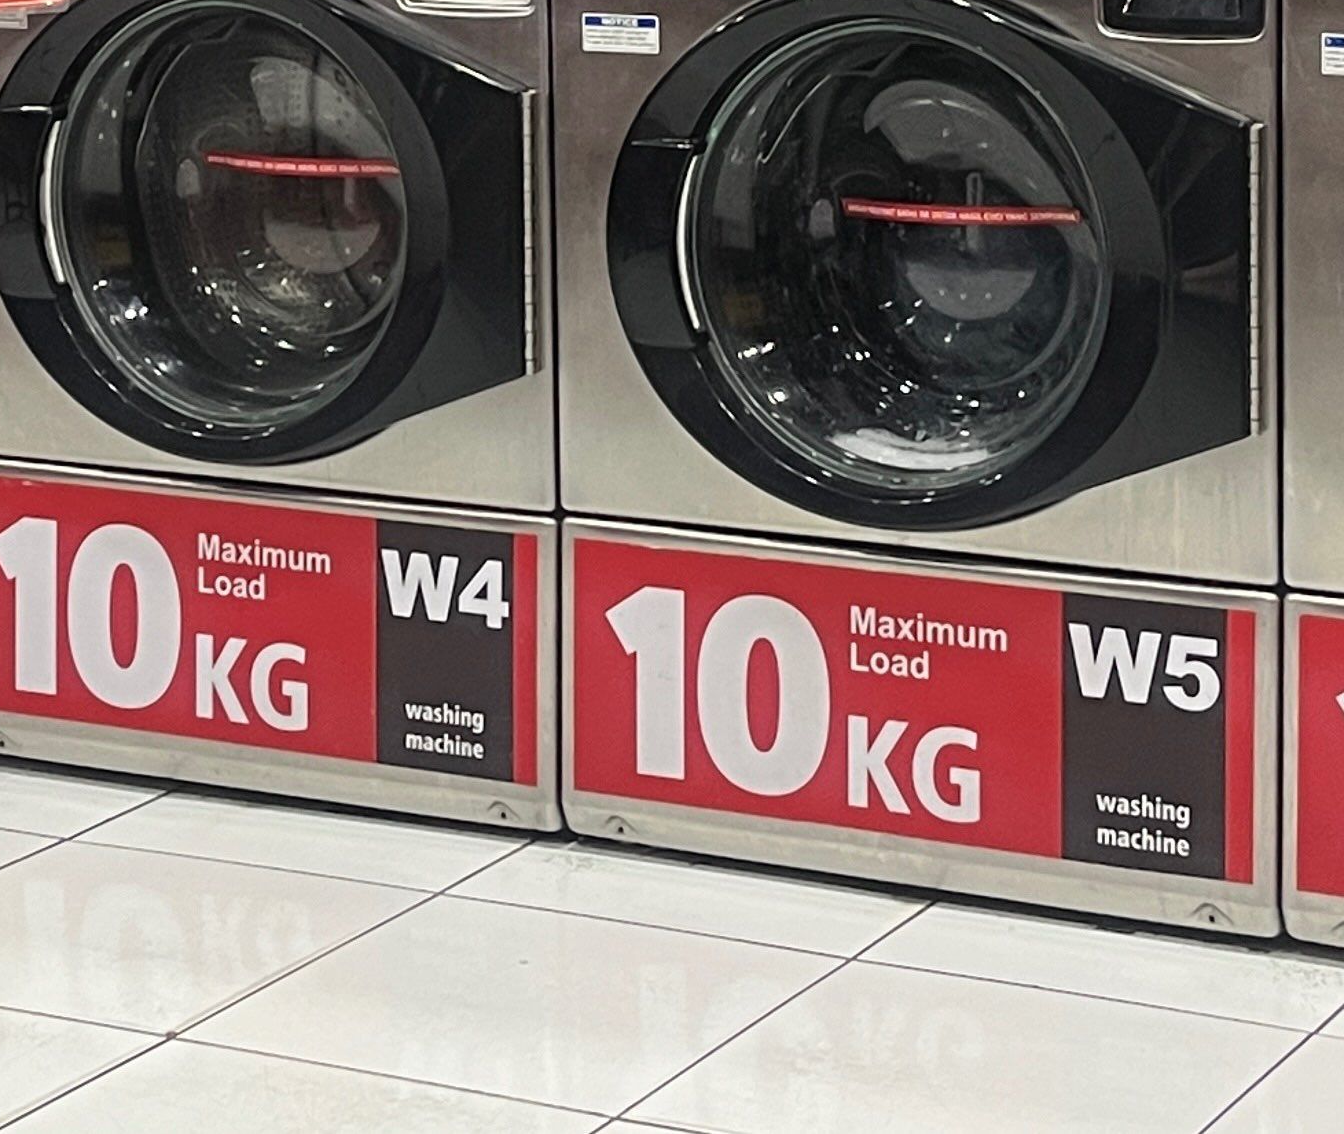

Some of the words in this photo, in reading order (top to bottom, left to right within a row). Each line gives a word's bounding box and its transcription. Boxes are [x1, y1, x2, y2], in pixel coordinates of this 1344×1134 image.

[198, 532, 331, 575] Maximum
[198, 568, 266, 601] Load
[381, 549, 509, 629] W4
[850, 605, 1008, 652] Maximum
[195, 633, 308, 731] KG
[850, 643, 931, 681] Load
[1068, 622, 1221, 712] W5
[405, 701, 484, 733] washing
[604, 586, 831, 797] 10
[847, 715, 981, 823] KG
[405, 731, 484, 759] machine
[1096, 792, 1190, 828] washing
[1097, 825, 1190, 857] machine
